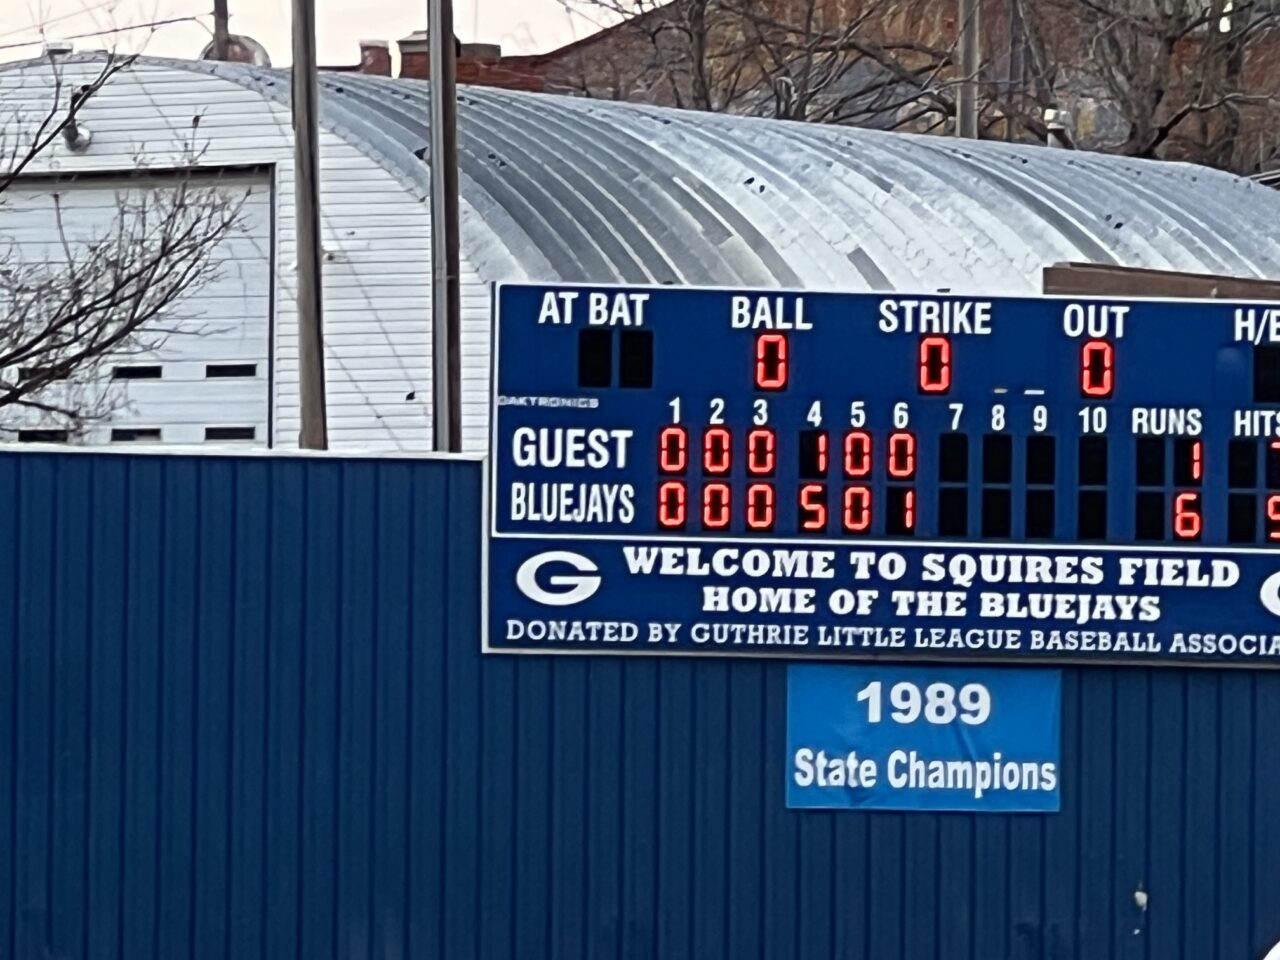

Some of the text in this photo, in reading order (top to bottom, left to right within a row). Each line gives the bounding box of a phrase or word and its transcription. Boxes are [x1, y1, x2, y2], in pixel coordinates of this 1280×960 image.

[539, 292, 649, 326] AT BAT
[732, 296, 812, 329] BALL
[879, 300, 991, 334] STRIKE
[1064, 304, 1129, 338] OUT
[757, 335, 786, 387] 0
[921, 338, 949, 390] 0
[1083, 342, 1112, 395] 0
[670, 397, 679, 423] 1
[710, 398, 724, 424] 2
[754, 399, 767, 425] 3
[807, 401, 822, 426] 4
[851, 401, 865, 427] 5
[894, 402, 908, 428] 6
[949, 404, 963, 430] 7
[992, 405, 1005, 430] 8
[1034, 406, 1047, 431] 9
[1079, 407, 1106, 433] 10
[1132, 408, 1201, 435] RUNS
[513, 427, 633, 468] GUEST
[661, 428, 685, 471] 0
[705, 429, 729, 472] 0
[749, 431, 774, 472] 0
[846, 432, 870, 475] 0
[889, 434, 913, 476] 0
[512, 483, 634, 523] BLUEJAYS
[660, 482, 685, 525] 0
[704, 484, 729, 526] 0
[748, 484, 772, 527] 0
[801, 485, 825, 528] 5
[845, 487, 870, 530] 0
[1175, 493, 1200, 536] 6
[517, 551, 601, 605] G
[623, 547, 1239, 587] WELCOME TO SQUIRES FIELD
[703, 587, 1160, 624] HOME OF THE BLUEJAYS
[507, 620, 638, 641] DONATED
[648, 623, 681, 642] BY
[691, 624, 808, 644] GUTHRIE
[818, 626, 905, 647] LITTLE
[915, 628, 1021, 649] LEAGUE
[1031, 630, 1161, 652] BASEBALL
[858, 682, 990, 724] 1989
[795, 748, 1056, 798] State Champions
